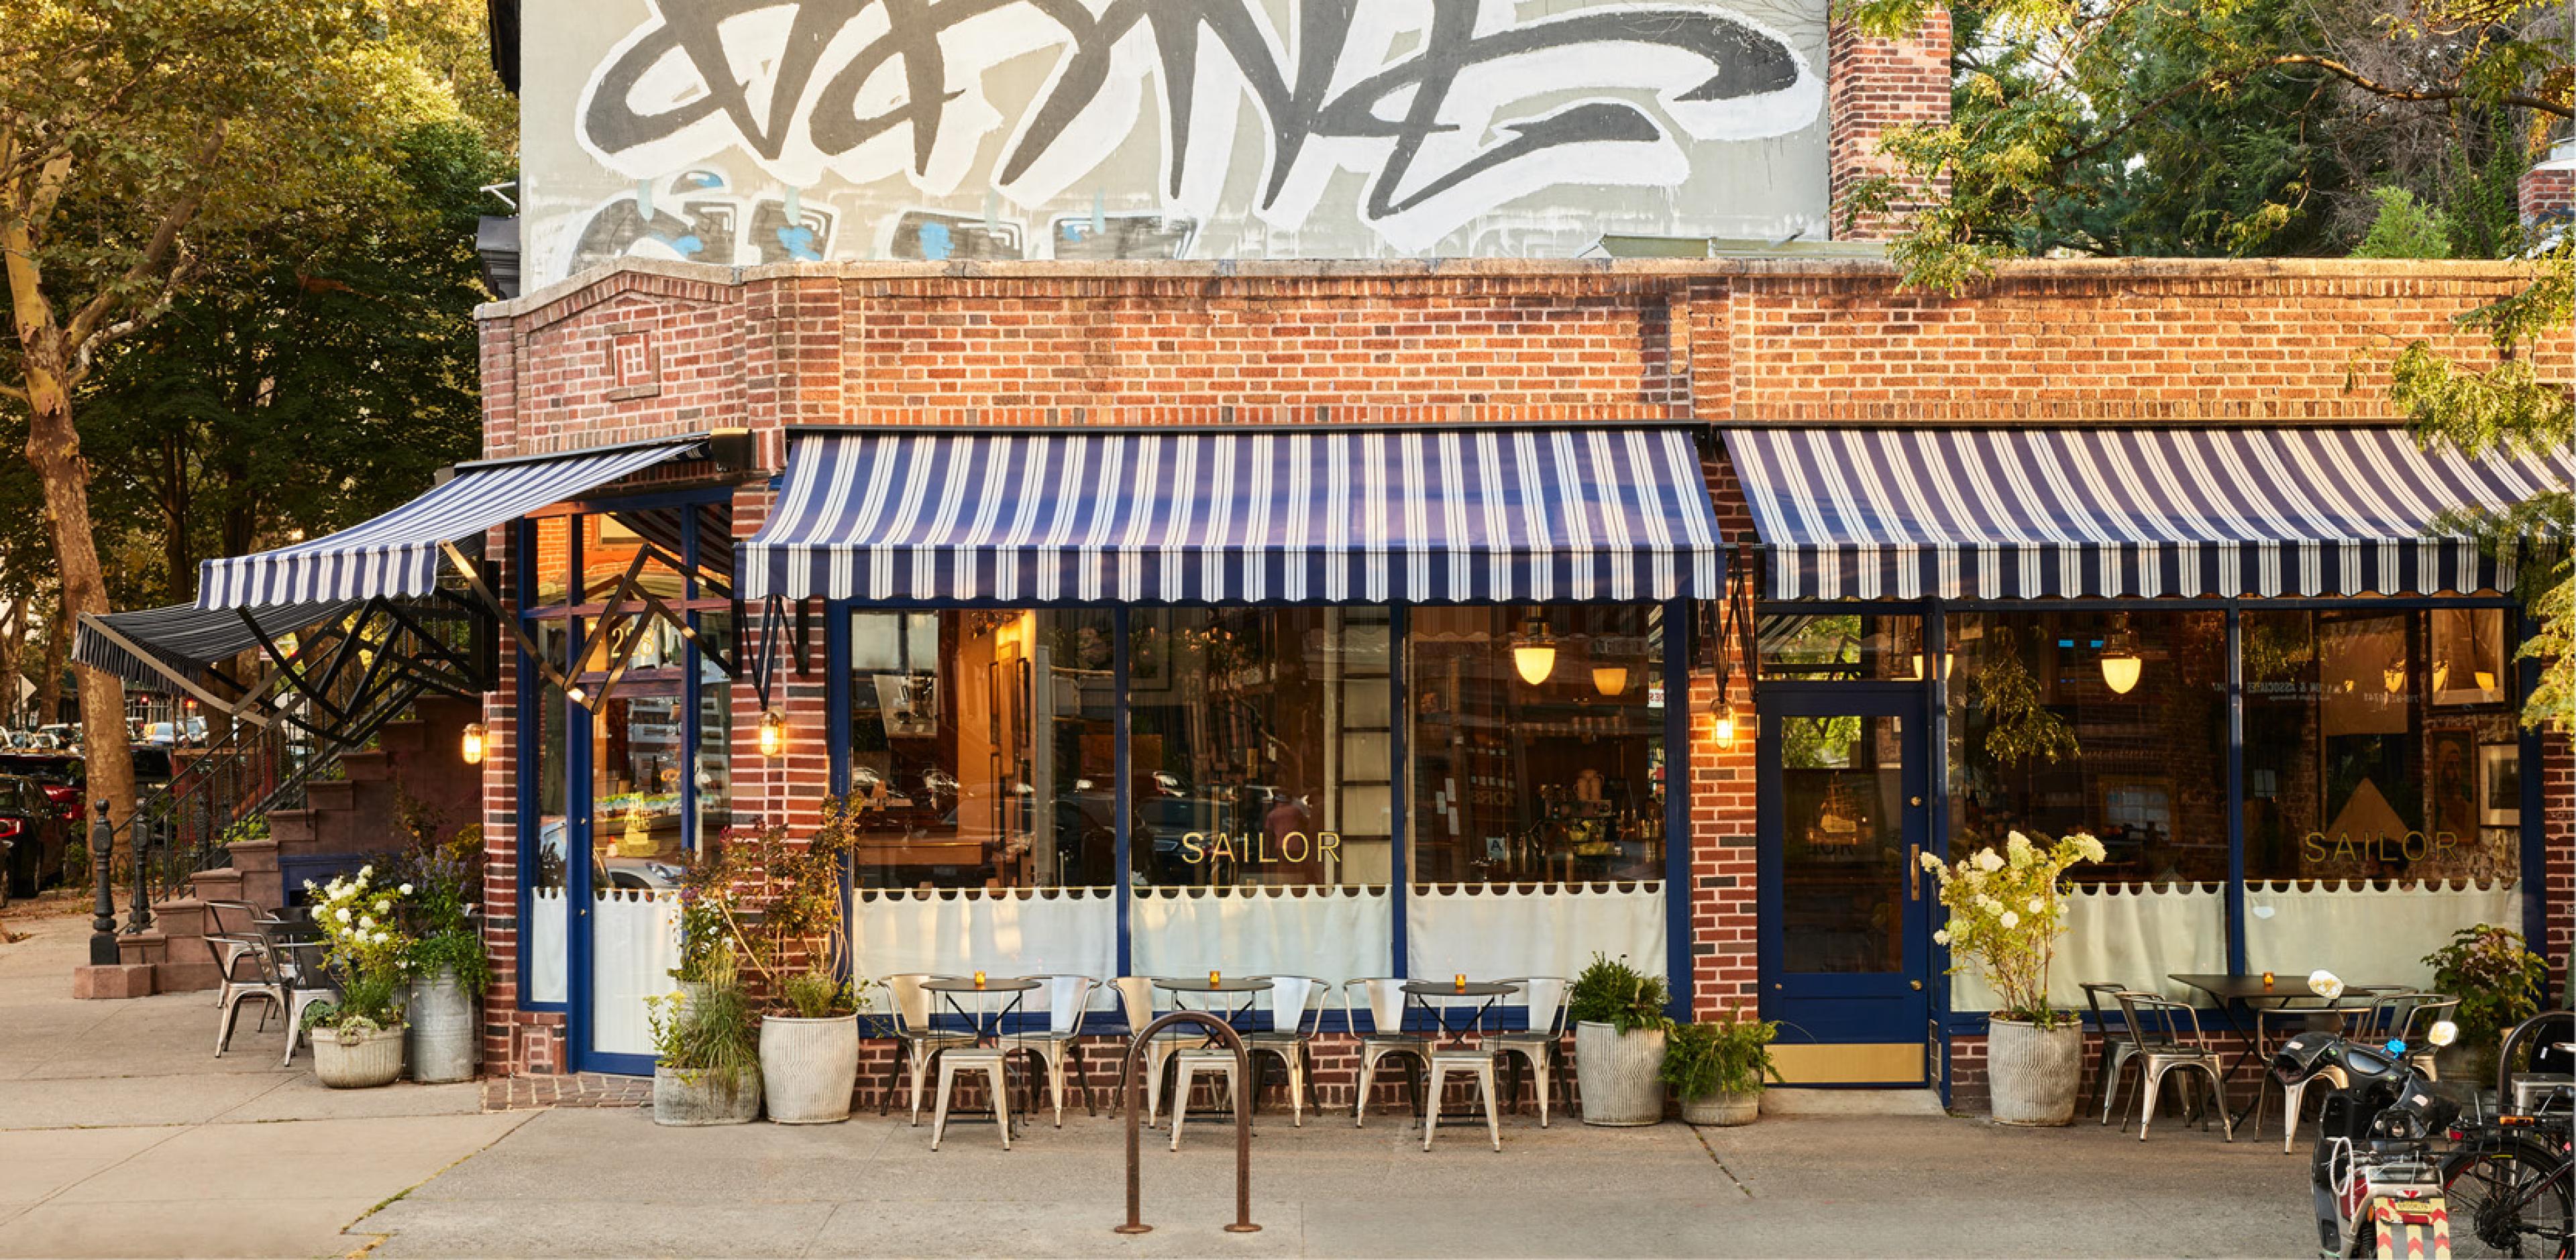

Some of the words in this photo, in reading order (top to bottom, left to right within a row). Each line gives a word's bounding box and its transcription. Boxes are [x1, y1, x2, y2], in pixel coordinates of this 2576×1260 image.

[1182, 832, 1340, 863] SAILOR
[1491, 840, 1503, 851] A
[2306, 831, 2458, 862] SAILOR
